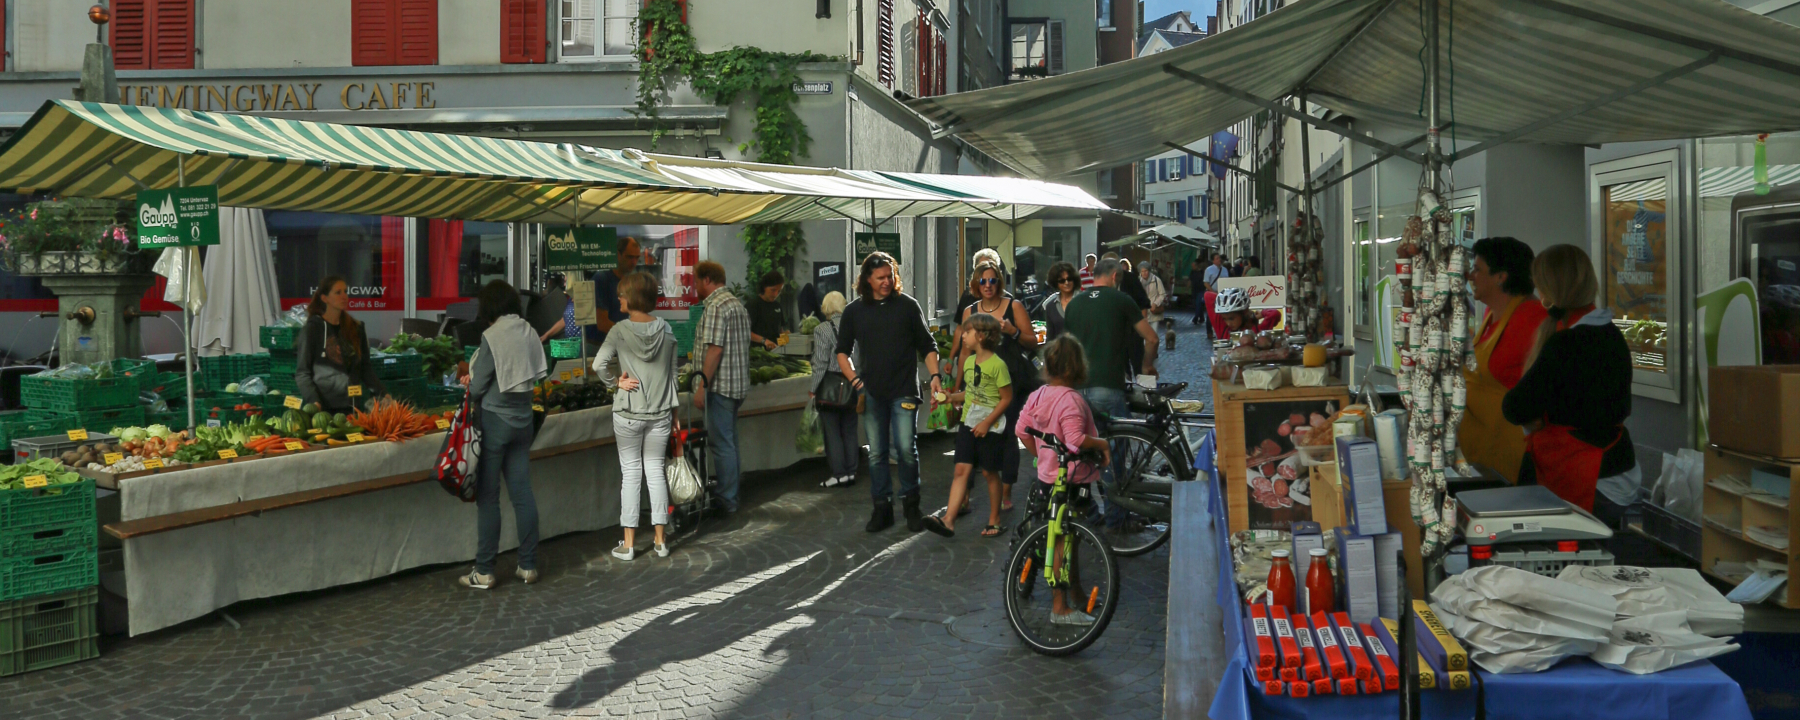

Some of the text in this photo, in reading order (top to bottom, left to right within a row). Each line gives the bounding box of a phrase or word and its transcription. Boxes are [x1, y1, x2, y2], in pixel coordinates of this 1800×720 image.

[340, 82, 436, 110] CAFE
[141, 209, 176, 227] Gaupp
[140, 234, 179, 244] Bio Gemüse
[549, 238, 576, 251] Gaupp
[1626, 245, 1645, 259] SEITE
[821, 266, 837, 275] rivella
[1616, 271, 1654, 285] GESCHICHTE
[309, 286, 387, 295] HGWAY
[348, 300, 365, 308] Café
[1419, 610, 1449, 636] SPAGHETTI
